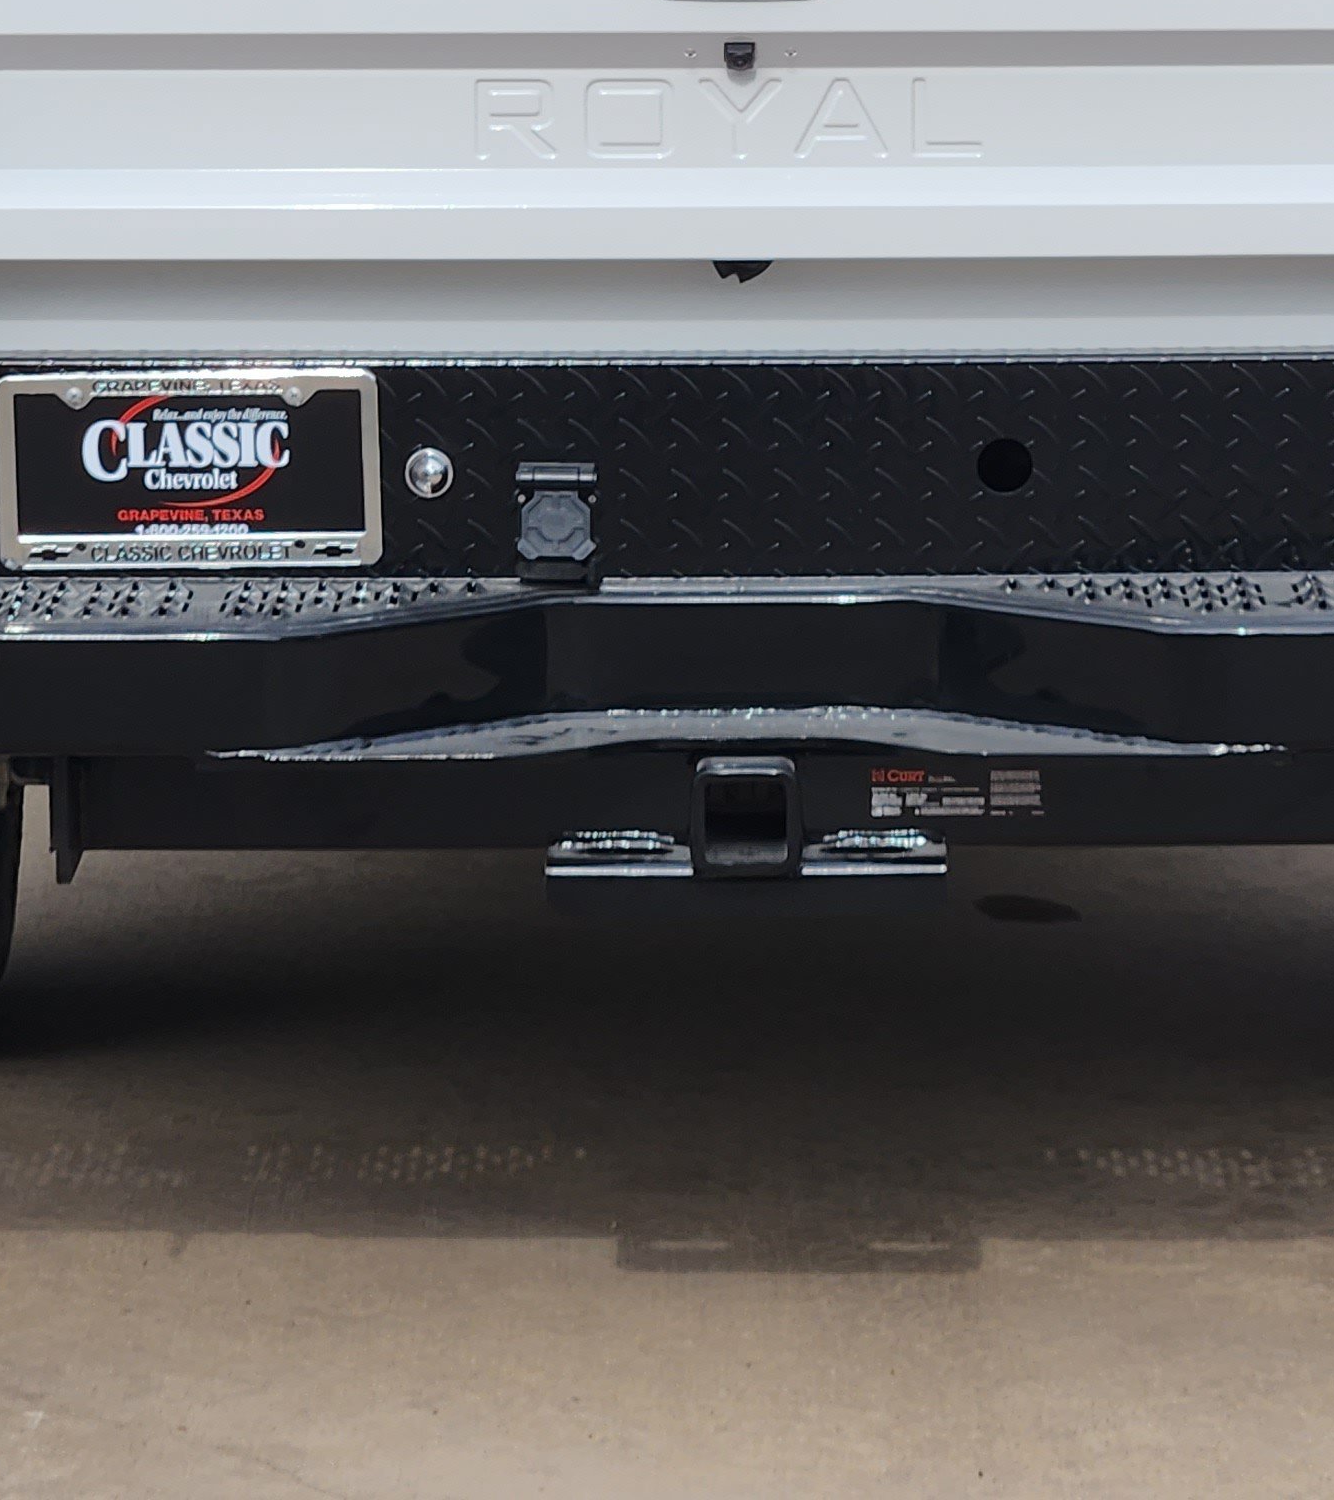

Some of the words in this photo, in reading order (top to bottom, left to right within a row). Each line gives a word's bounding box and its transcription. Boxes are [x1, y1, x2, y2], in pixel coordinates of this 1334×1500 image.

[475, 77, 983, 159] ROYAL
[82, 419, 290, 481] CLASSIC
[144, 468, 238, 490] Chevrolet
[117, 509, 209, 523] GRAPEVINE,
[212, 508, 265, 522] TEXAS
[91, 543, 172, 562] CLASSIC
[178, 541, 292, 561] CHEVROLET
